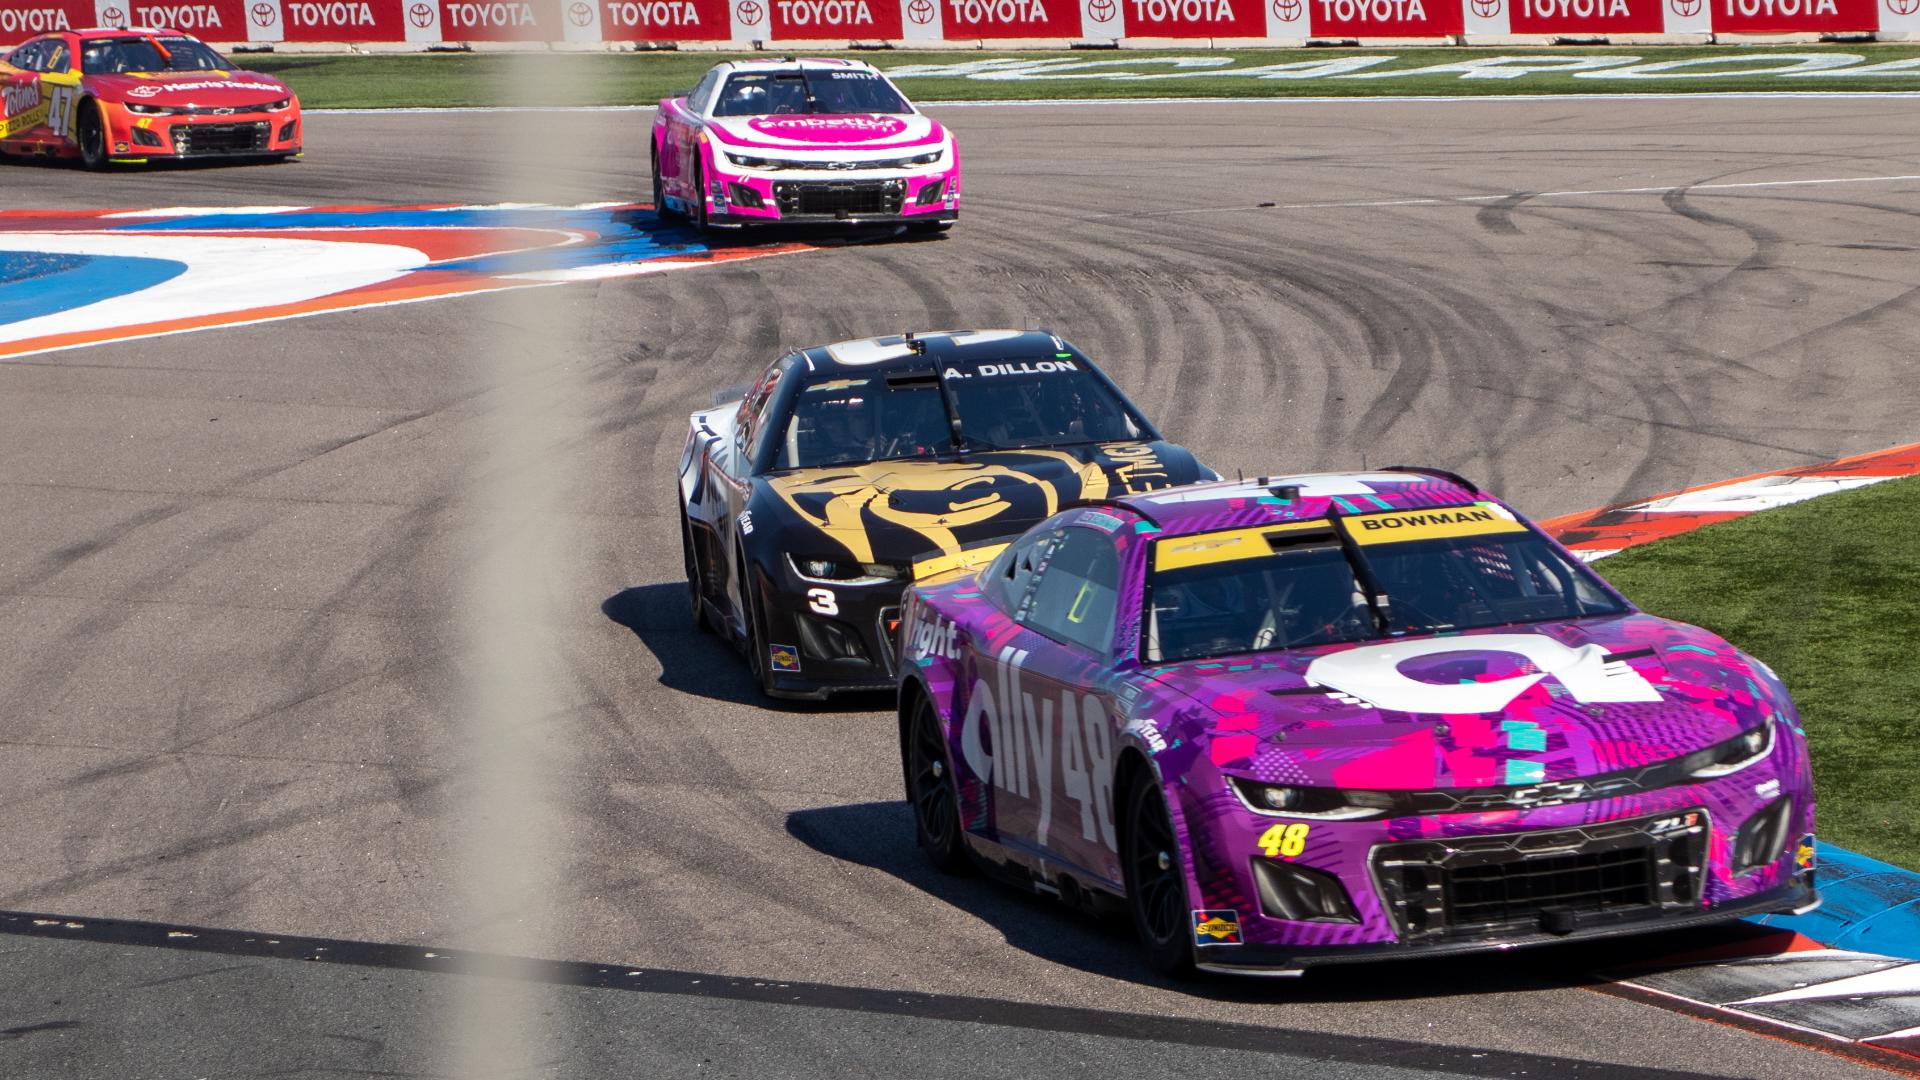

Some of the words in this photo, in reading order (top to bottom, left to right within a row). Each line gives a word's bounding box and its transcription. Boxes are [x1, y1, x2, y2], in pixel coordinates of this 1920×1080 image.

[0, 9, 71, 32] OYOTA
[137, 6, 222, 29] TOYOTA
[289, 2, 376, 26] TOYOTA
[447, 3, 537, 27] TOYOTA
[607, 1, 700, 27] TOYOTA
[778, 0, 873, 25] TOYOTA
[949, 0, 1049, 24] TOYOTA
[1131, 0, 1236, 22] TOYOTA
[1318, 0, 1427, 22] TOYOTA
[163, 81, 224, 92] Harris
[831, 72, 880, 81] SMITH
[49, 86, 72, 136] 47
[943, 367, 972, 380] A.
[978, 360, 1079, 378] DILLON
[1360, 509, 1495, 531] BOWMAN
[807, 588, 840, 616] 3
[1257, 822, 1311, 858] 48
